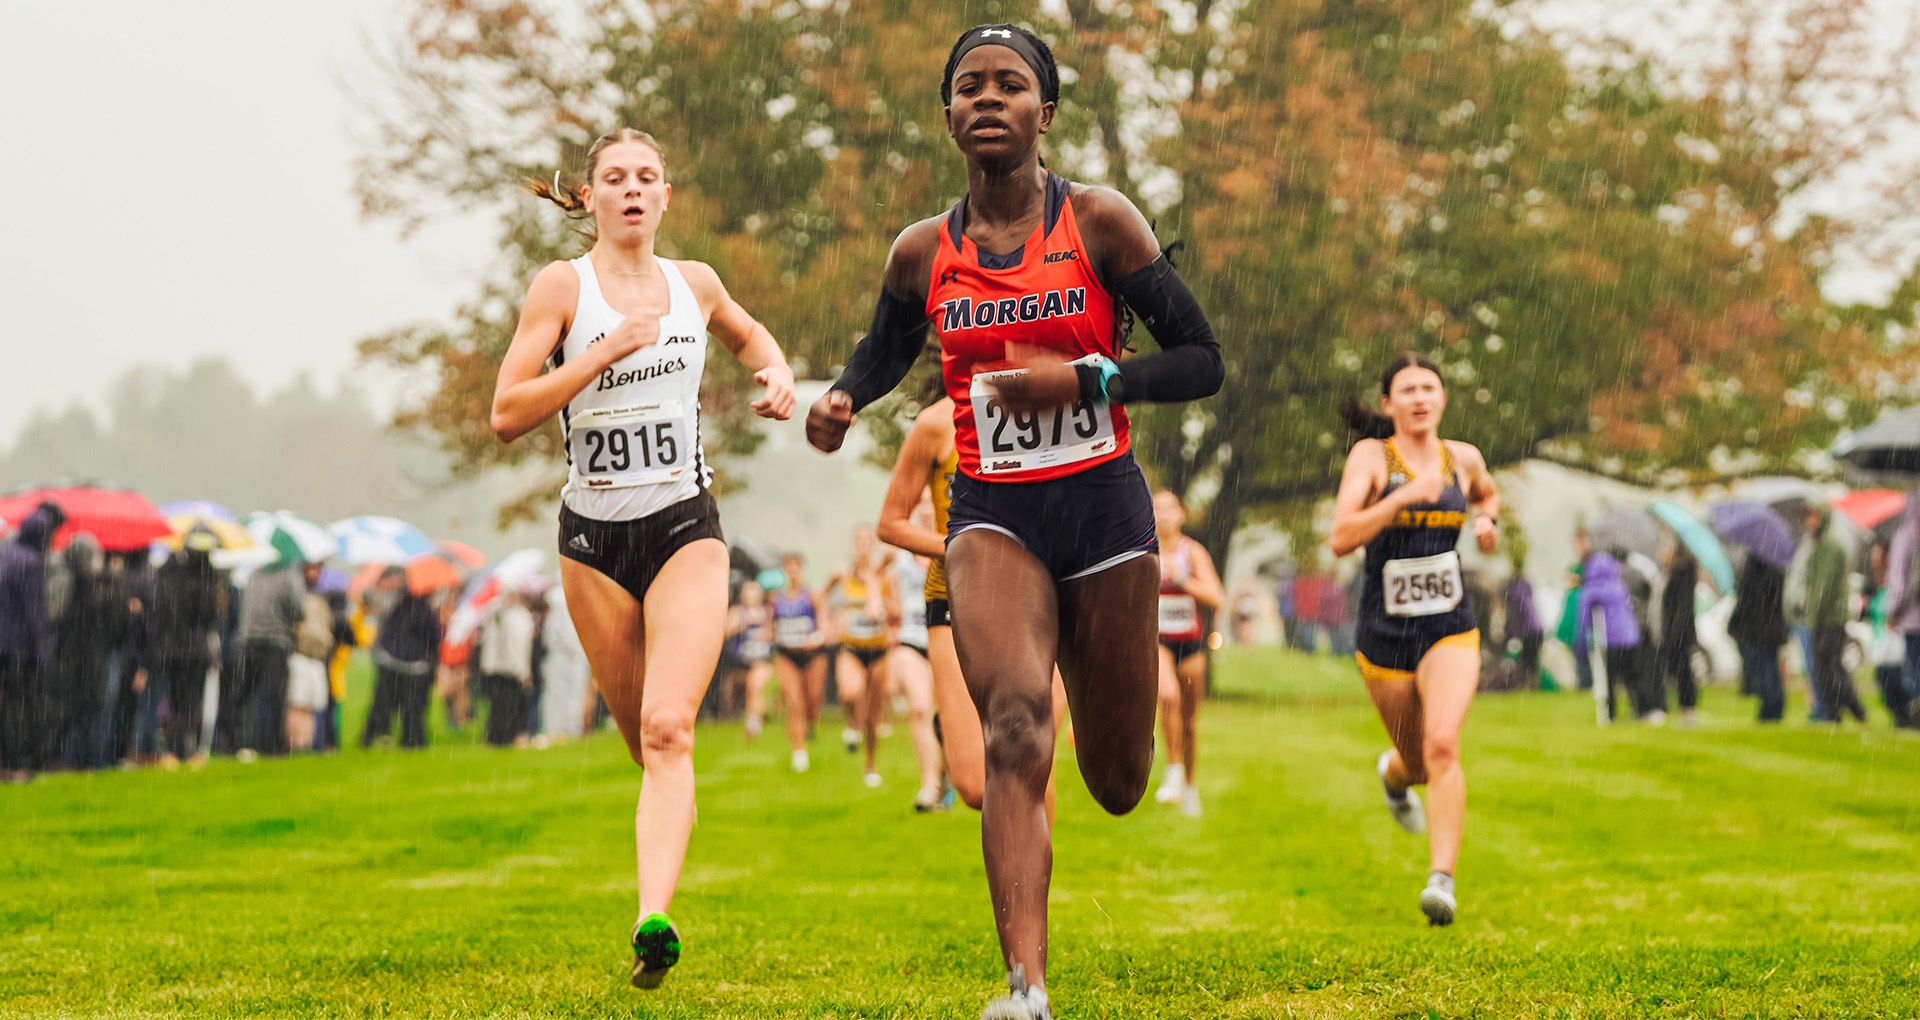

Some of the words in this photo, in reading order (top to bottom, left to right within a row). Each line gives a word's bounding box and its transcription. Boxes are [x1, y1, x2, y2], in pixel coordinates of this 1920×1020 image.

[1044, 249, 1078, 264] MEAC
[597, 356, 687, 392] Bonnies
[986, 399, 1098, 452] 2975
[586, 422, 677, 473] 2915
[1392, 569, 1454, 605] 2566
